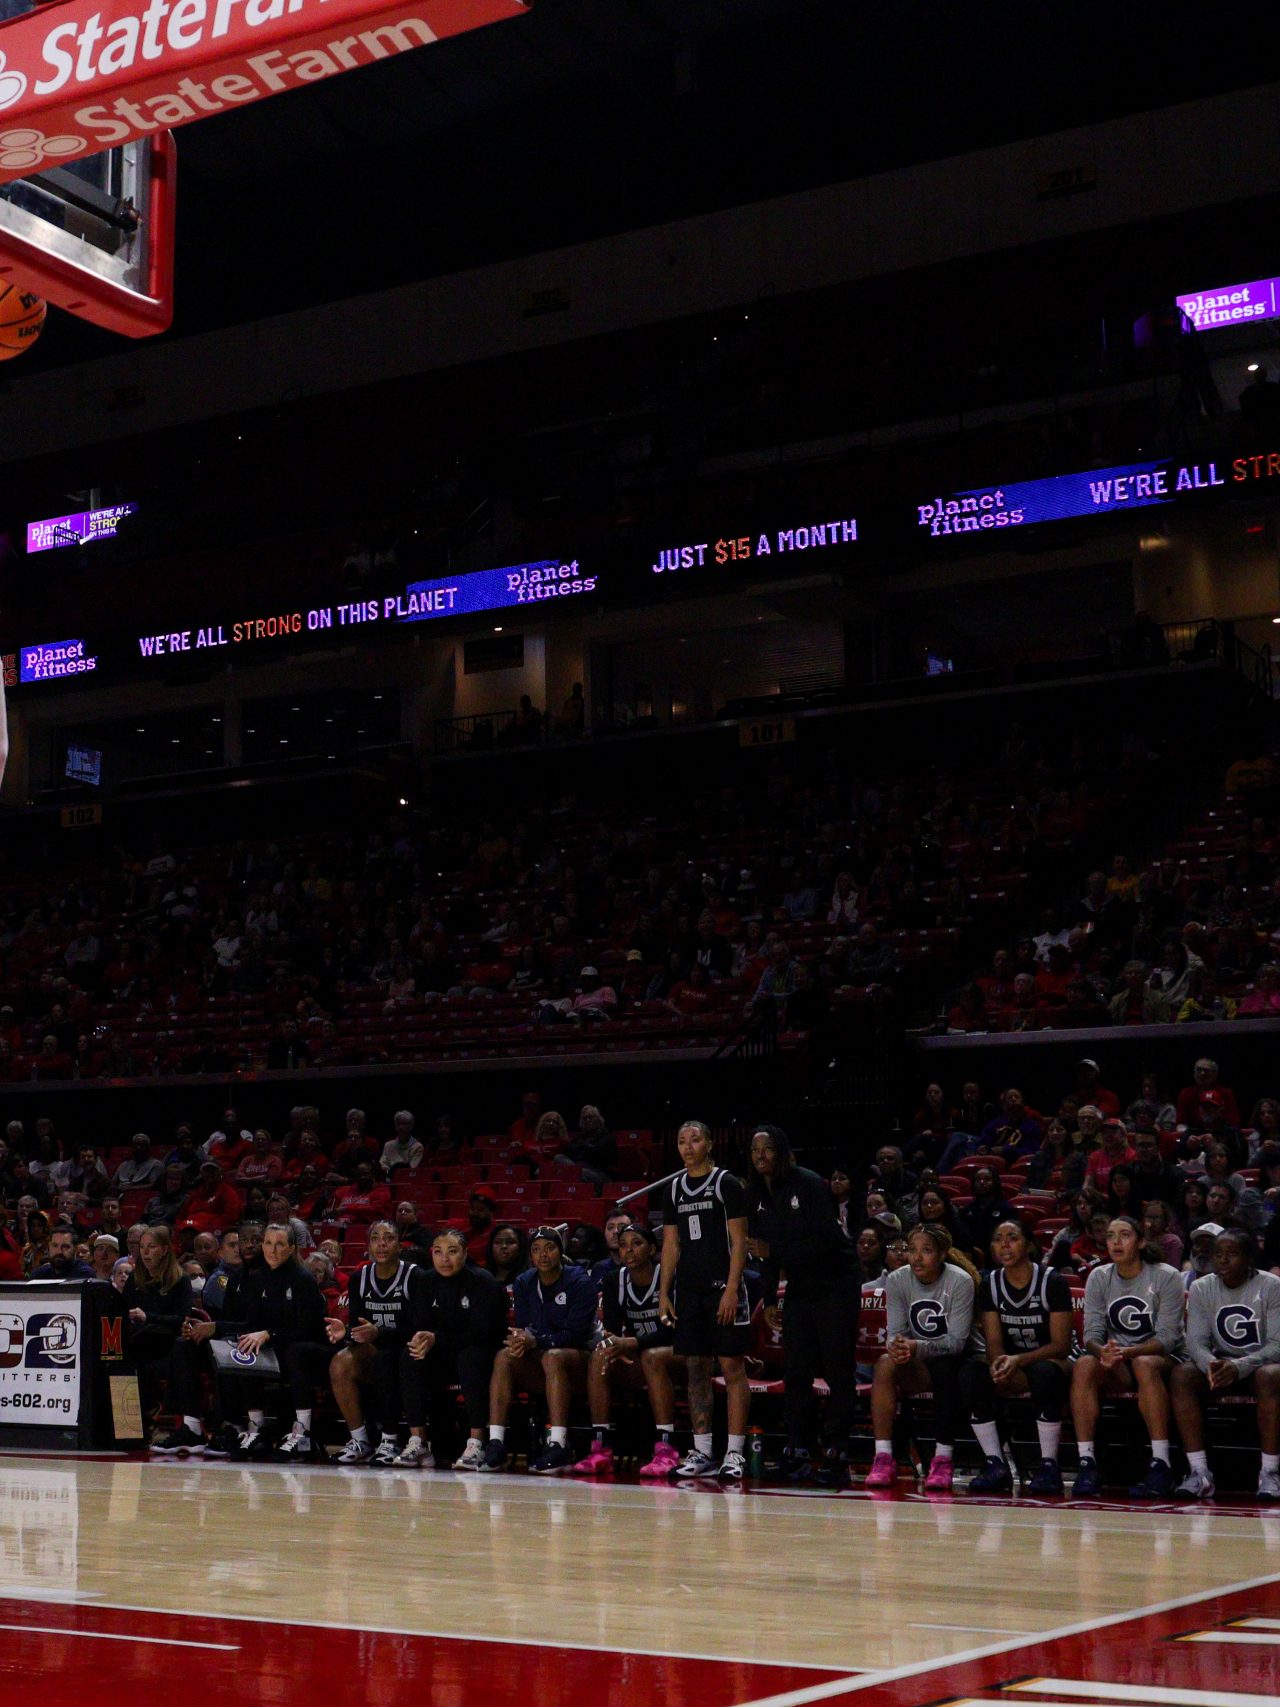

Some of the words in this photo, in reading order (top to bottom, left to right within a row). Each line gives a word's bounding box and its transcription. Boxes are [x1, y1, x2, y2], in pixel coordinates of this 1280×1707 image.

[75, 18, 438, 142] StateFarm
[1183, 288, 1250, 317] planet
[1194, 303, 1266, 327] fitness
[1089, 471, 1168, 504] WE'RE
[1176, 463, 1225, 490] ALL
[1232, 453, 1280, 482] STR
[918, 490, 1005, 525] planet
[930, 509, 1024, 536] fitness
[652, 544, 708, 573] JUST
[714, 537, 750, 564] $15
[756, 534, 771, 556] A
[778, 519, 857, 552] MONTH
[507, 560, 579, 591] planet
[517, 576, 597, 602] fitness
[139, 631, 191, 657] WE'RE
[196, 626, 228, 648] ALL
[233, 613, 302, 642] STRONG
[307, 608, 332, 630] ON
[337, 600, 379, 625] THIS
[384, 587, 458, 618] PLANET
[27, 641, 84, 669] planet
[34, 656, 97, 679] fitness
[909, 1299, 949, 1339] G
[1108, 1295, 1154, 1337] G
[1216, 1304, 1262, 1348] G
[100, 1316, 123, 1355] M
